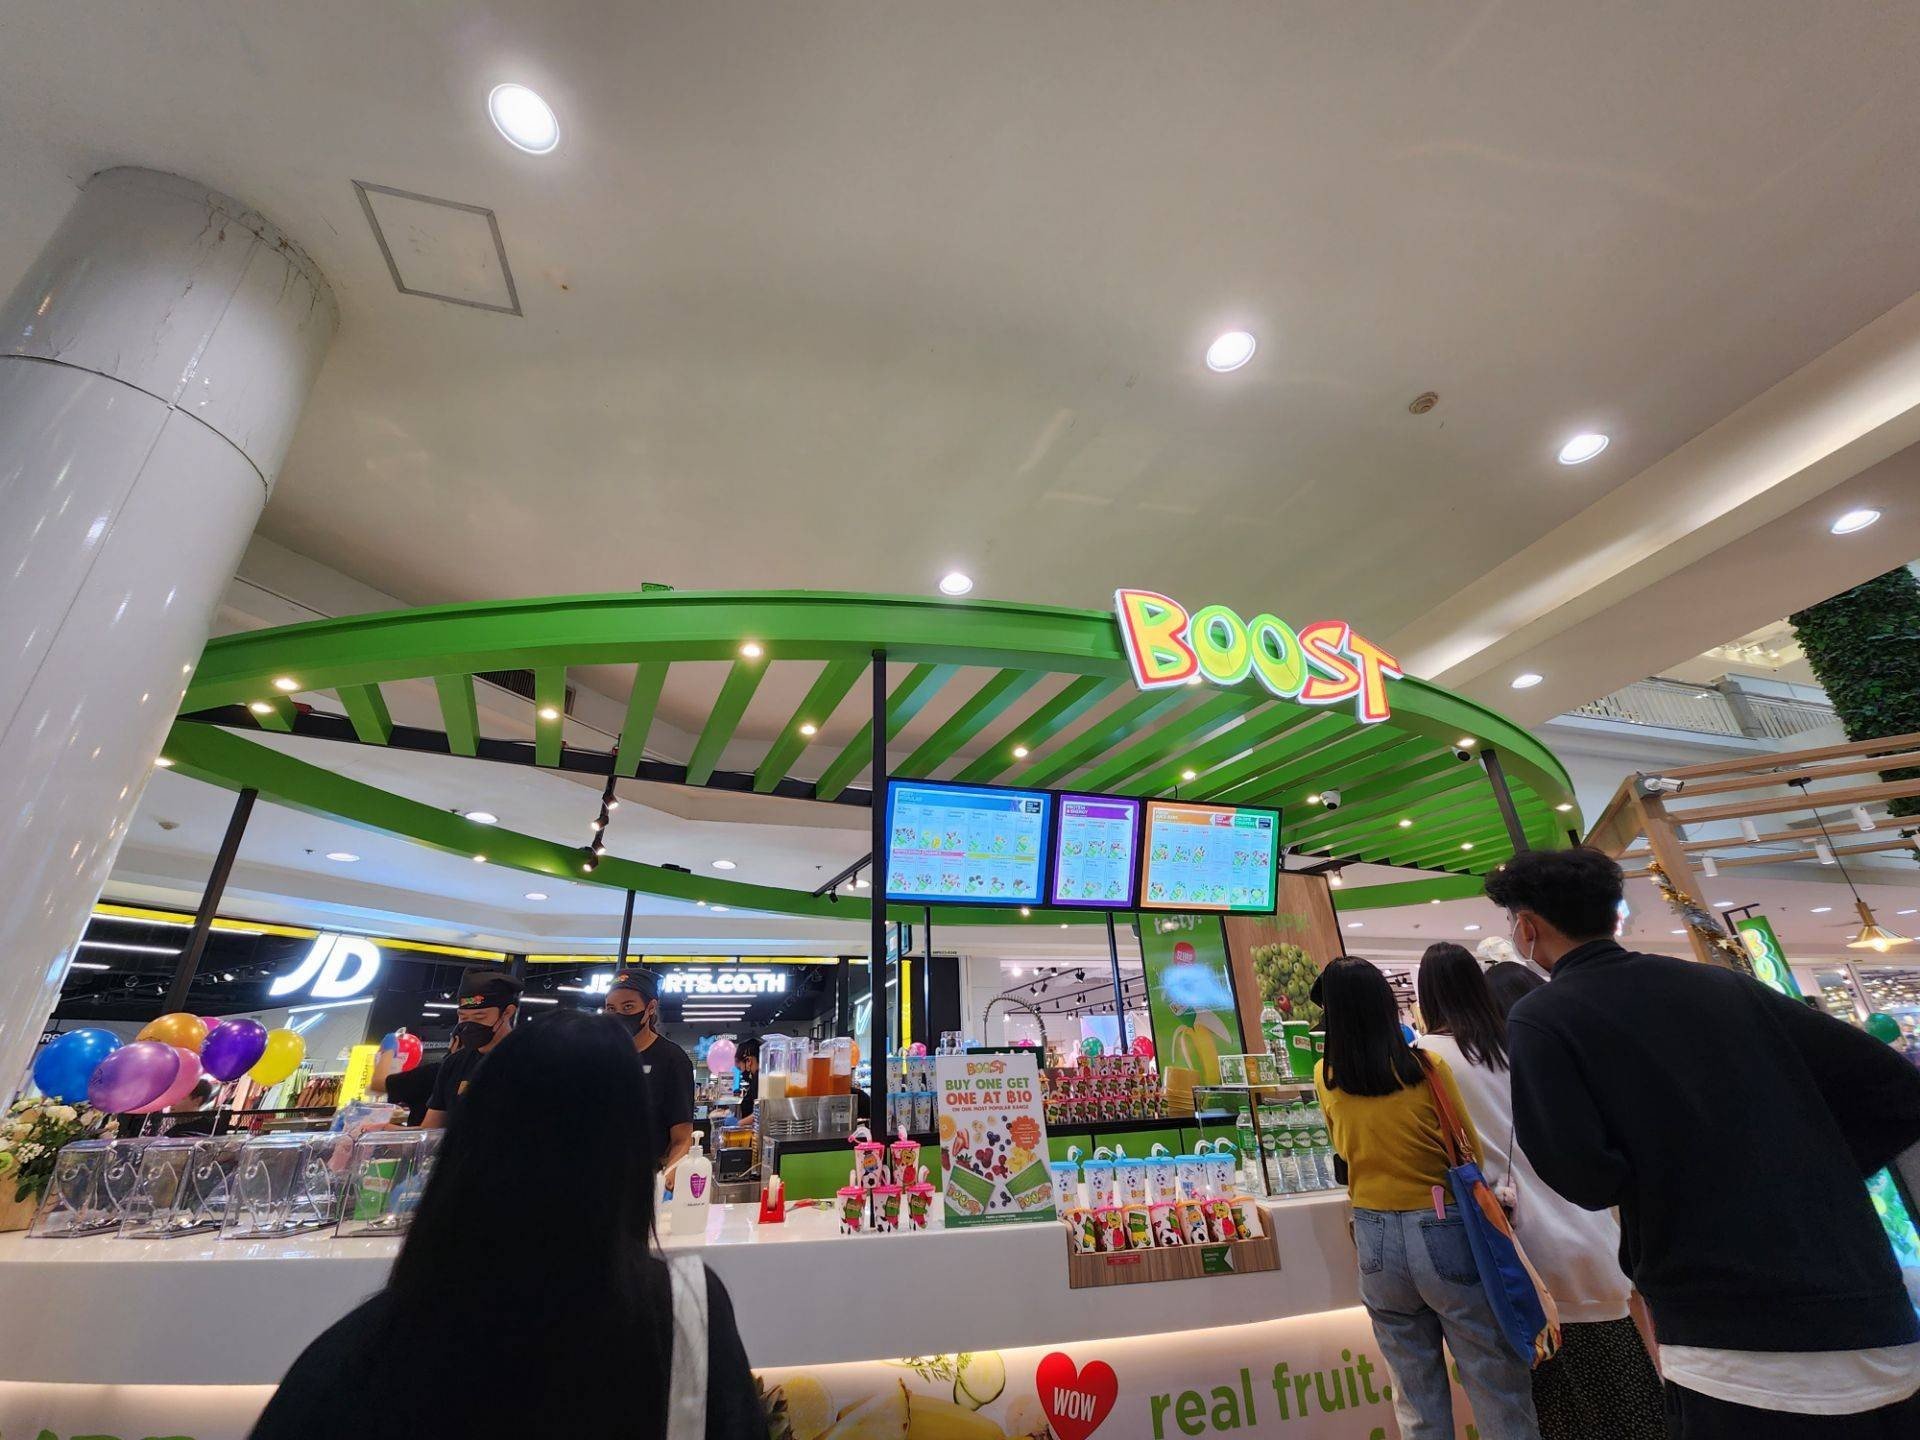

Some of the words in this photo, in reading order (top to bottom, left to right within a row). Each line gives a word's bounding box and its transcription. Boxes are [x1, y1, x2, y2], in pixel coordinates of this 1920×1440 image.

[1113, 588, 1404, 724] BOOST
[268, 932, 381, 998] JD
[945, 1080, 970, 1091] BUY
[975, 1078, 1003, 1090] ONE
[1007, 1077, 1030, 1089] GET
[966, 1060, 1007, 1076] BOOST
[946, 1092, 977, 1105] ONE
[983, 1091, 1001, 1104] AT
[1052, 1386, 1097, 1423] WOW
[1149, 1367, 1258, 1440] real
[1271, 1348, 1394, 1421] fruit.
